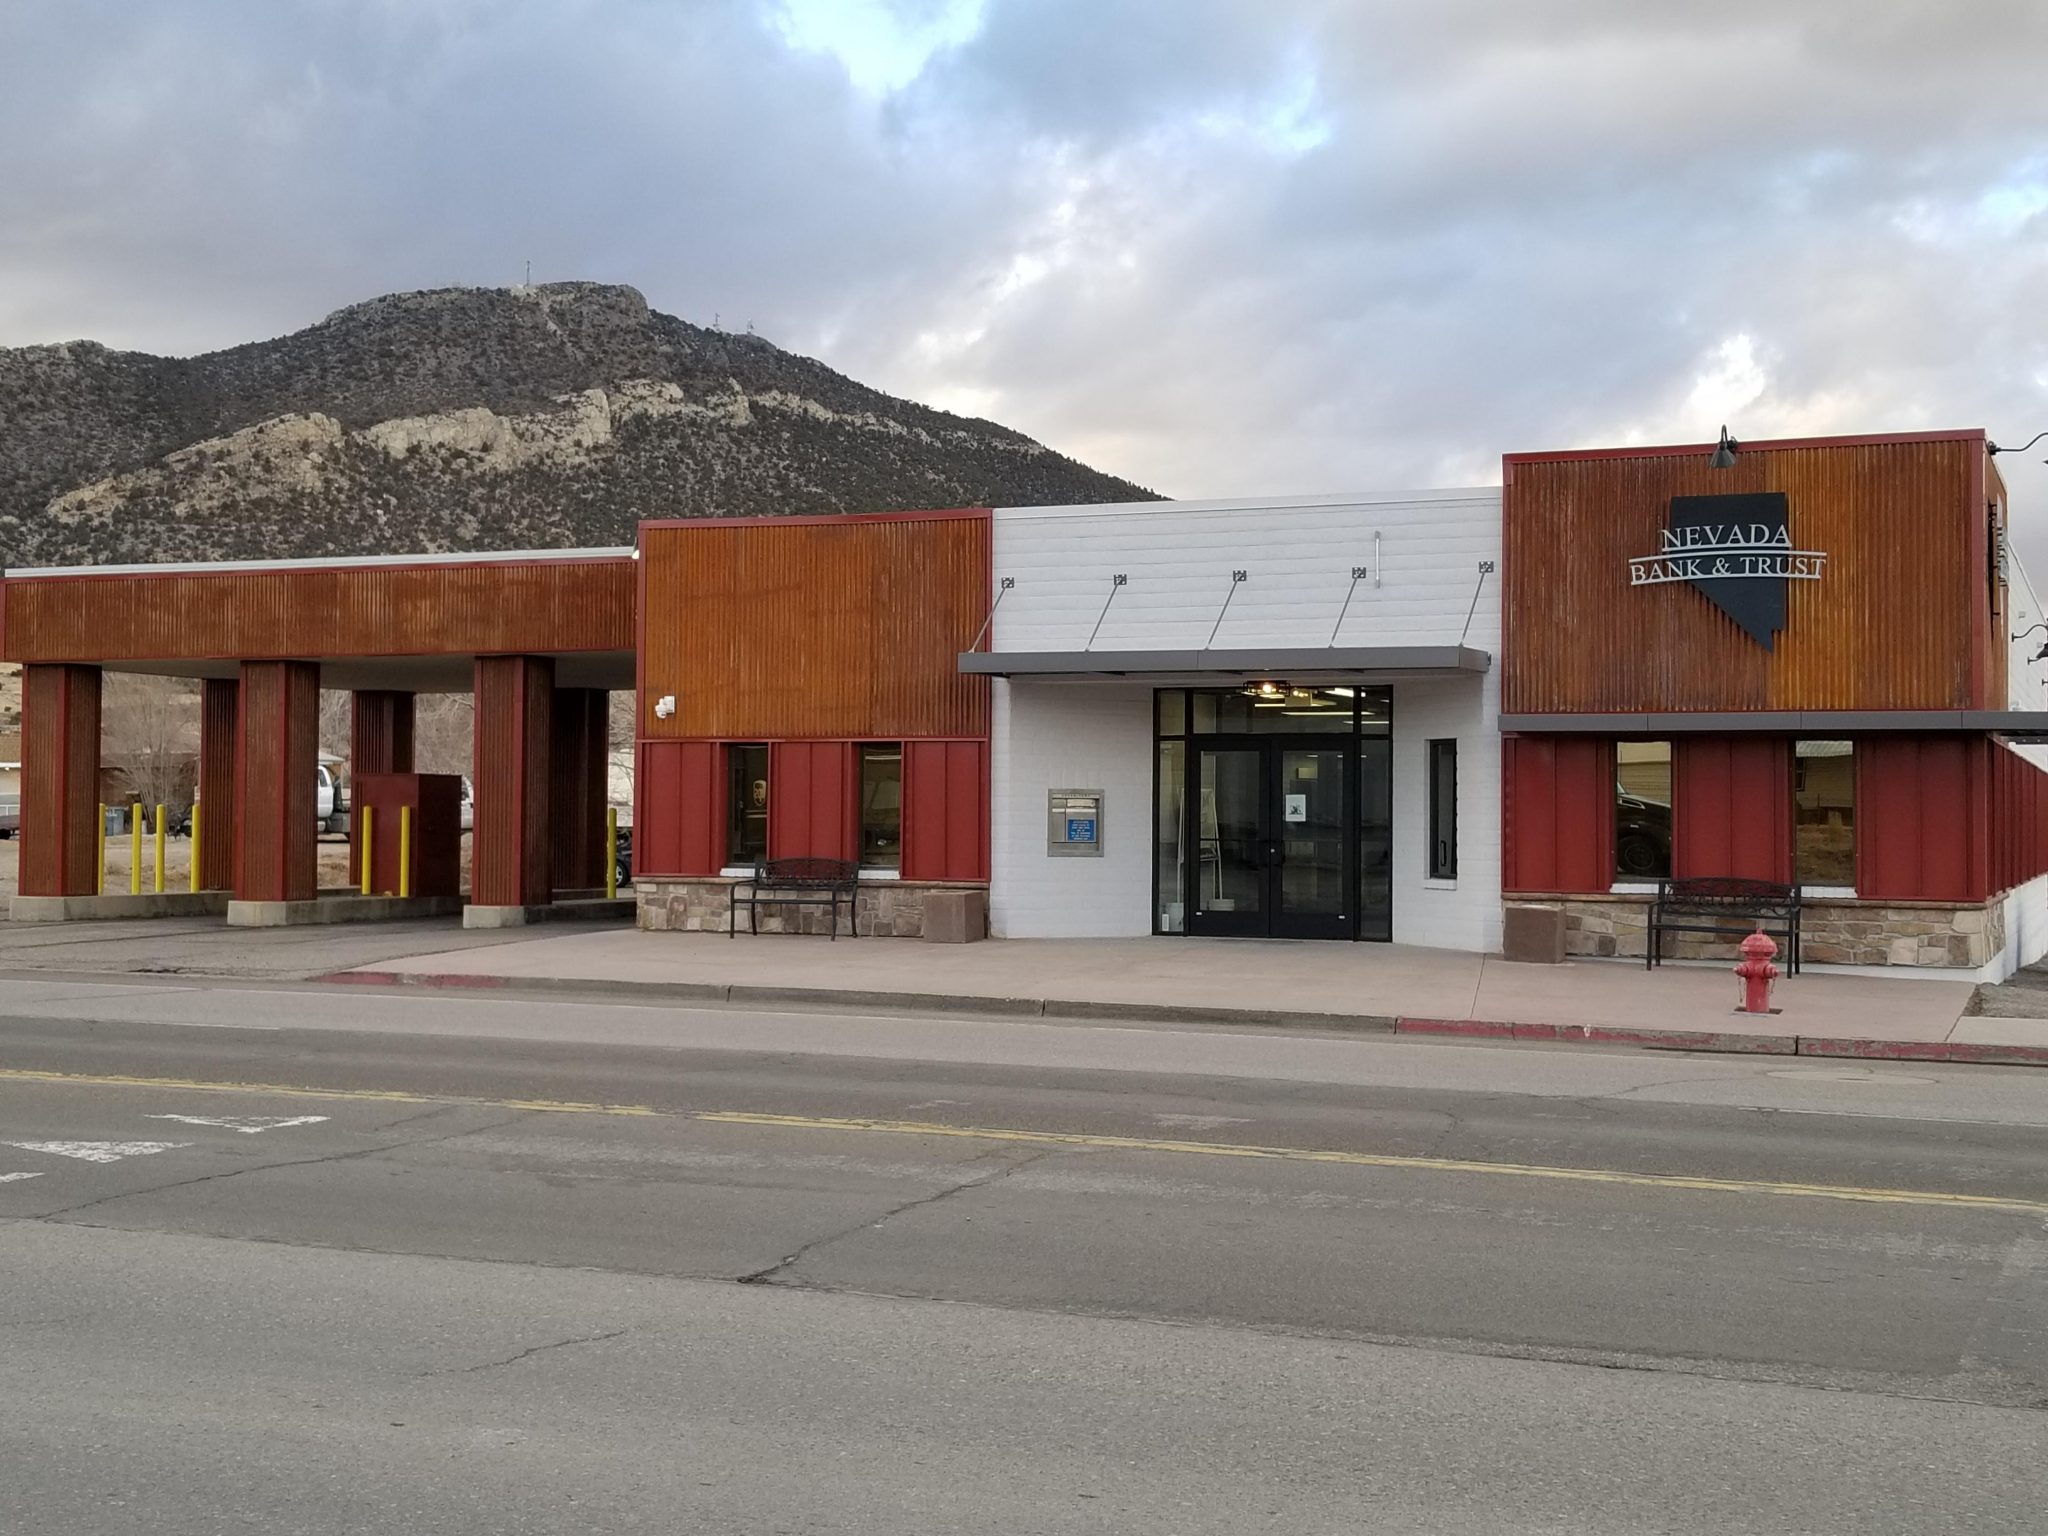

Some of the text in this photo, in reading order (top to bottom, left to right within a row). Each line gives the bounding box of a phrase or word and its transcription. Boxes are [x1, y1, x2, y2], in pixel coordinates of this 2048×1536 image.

[1661, 524, 1792, 549] NEVADA
[1630, 556, 1826, 584] BANK & TRUST
